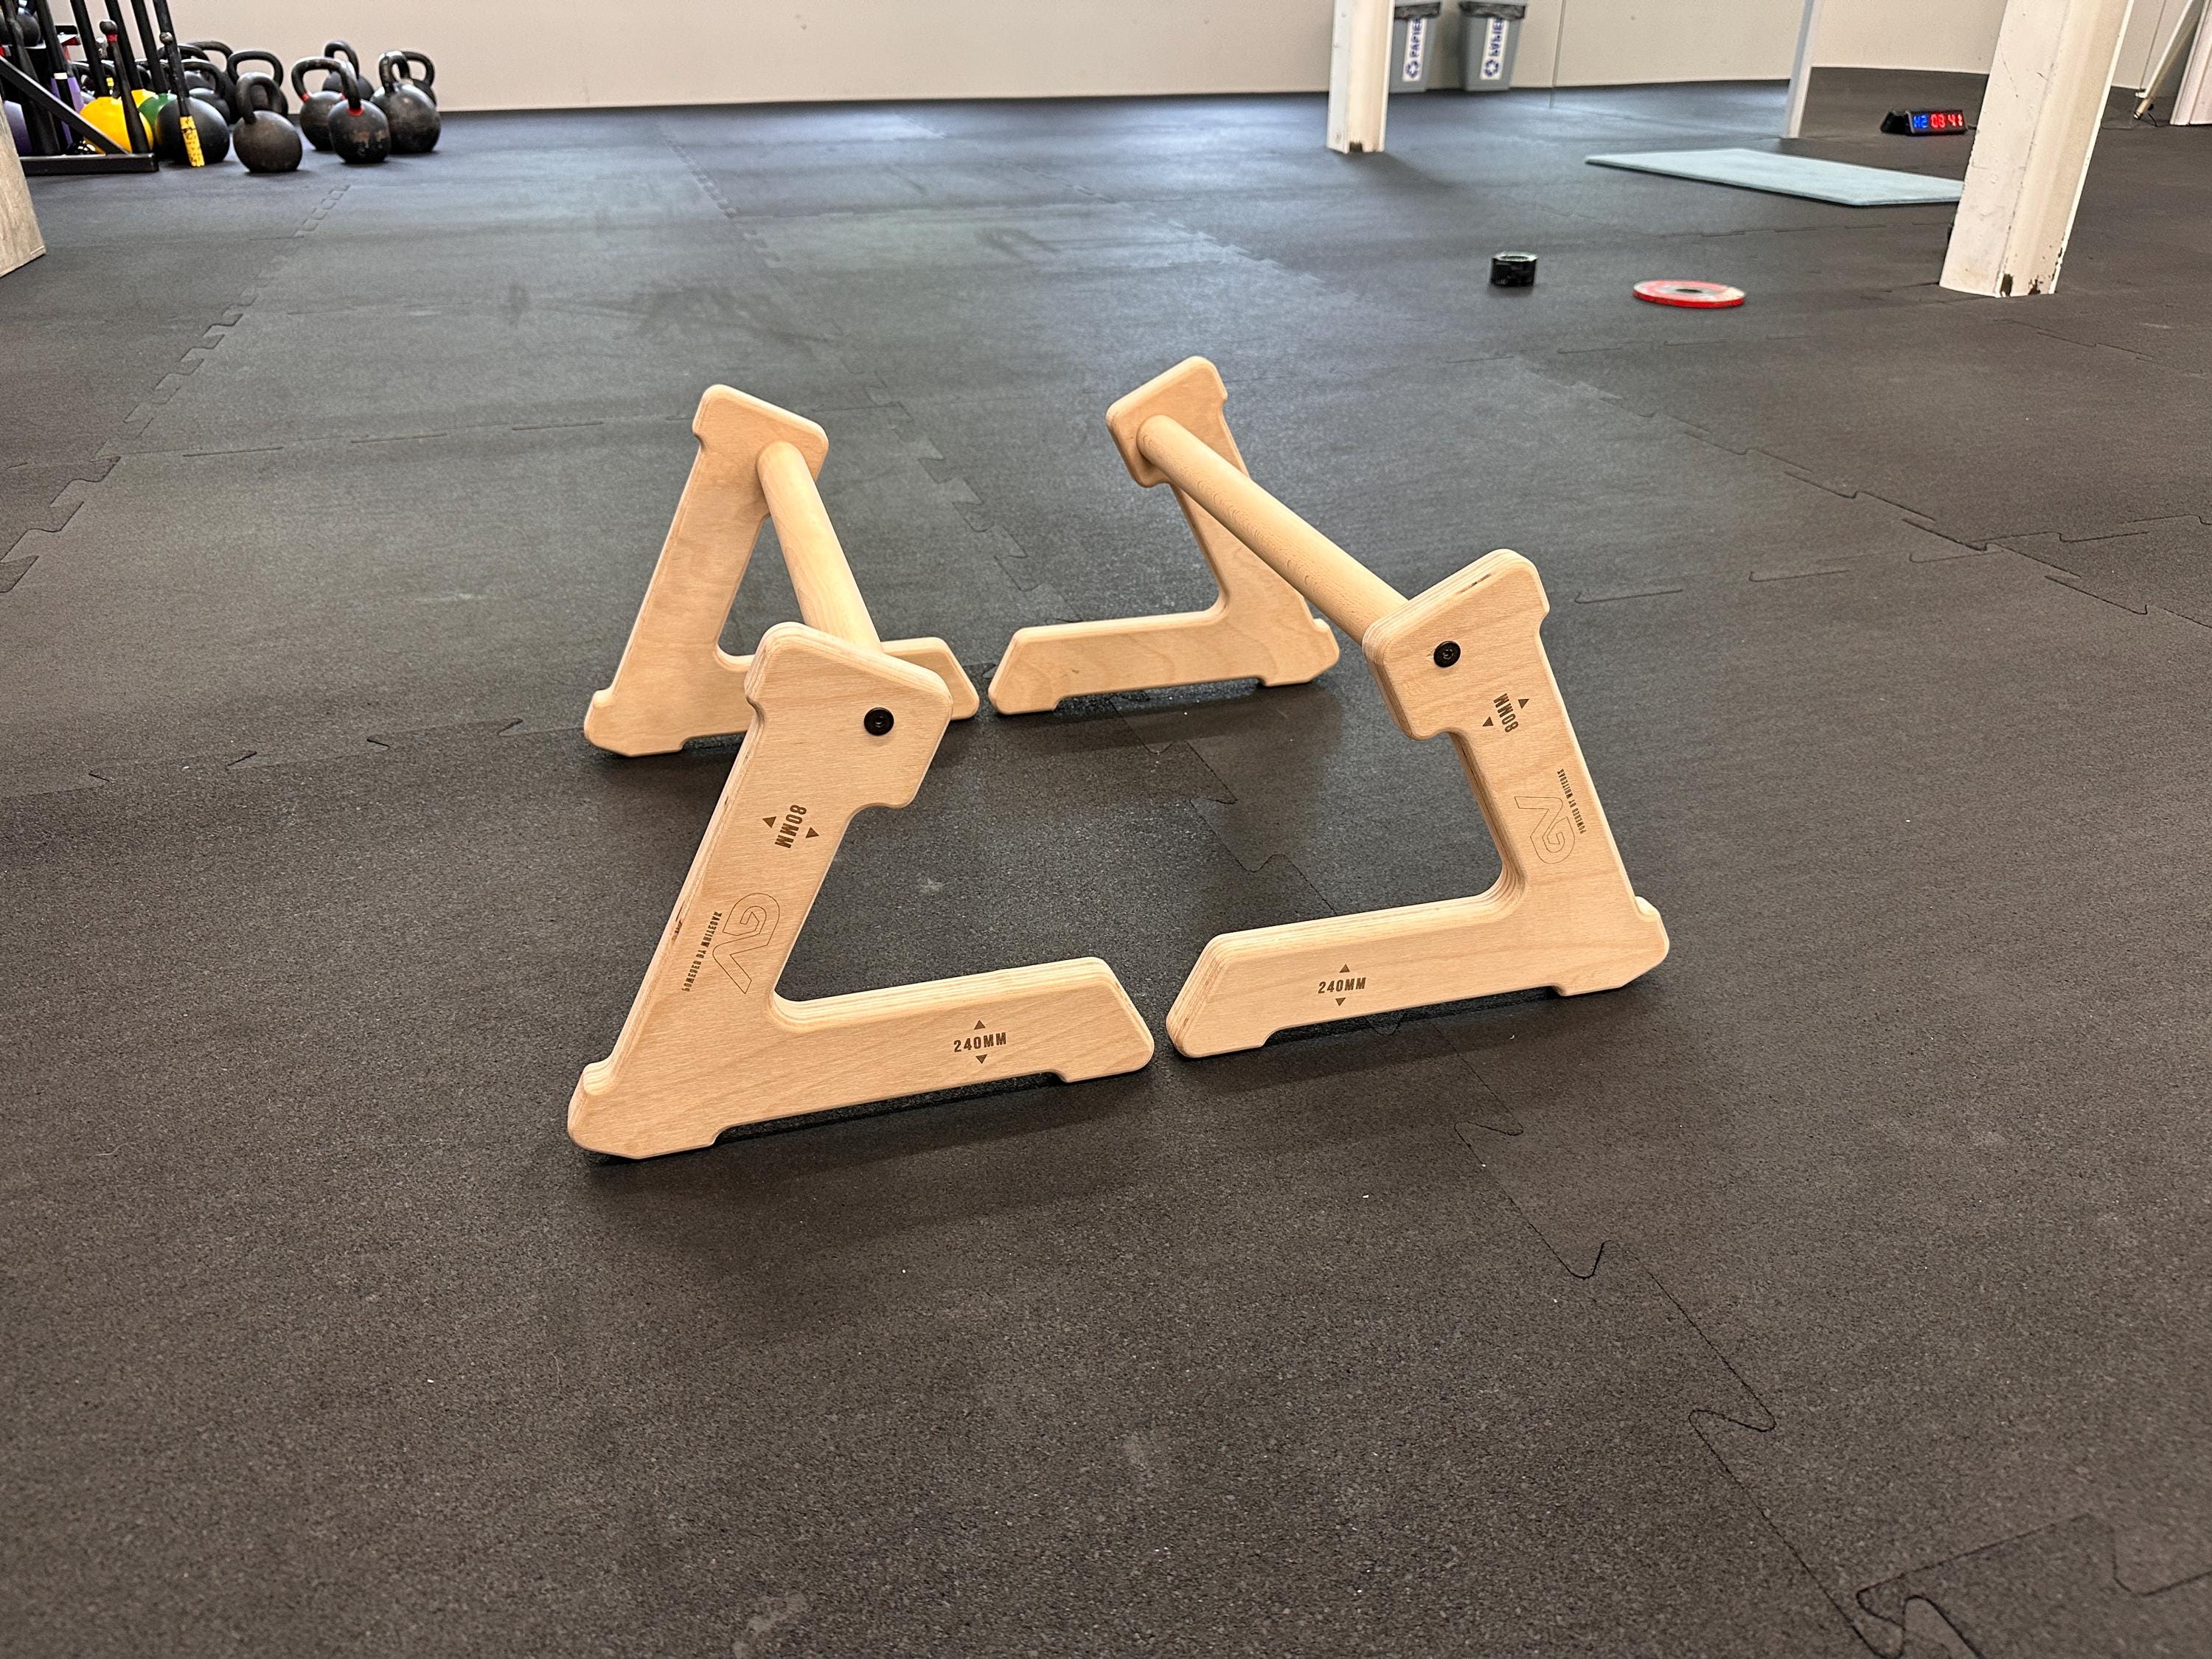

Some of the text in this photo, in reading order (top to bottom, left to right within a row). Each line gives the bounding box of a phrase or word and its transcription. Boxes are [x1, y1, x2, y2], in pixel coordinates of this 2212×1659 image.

[1493, 693, 1519, 733] 80MM
[1557, 768, 1587, 835] POWERED BY WHITEOAK
[774, 804, 807, 849] 80MM
[1318, 977, 1366, 994] 240MM
[953, 1032, 1006, 1053] 240MM
